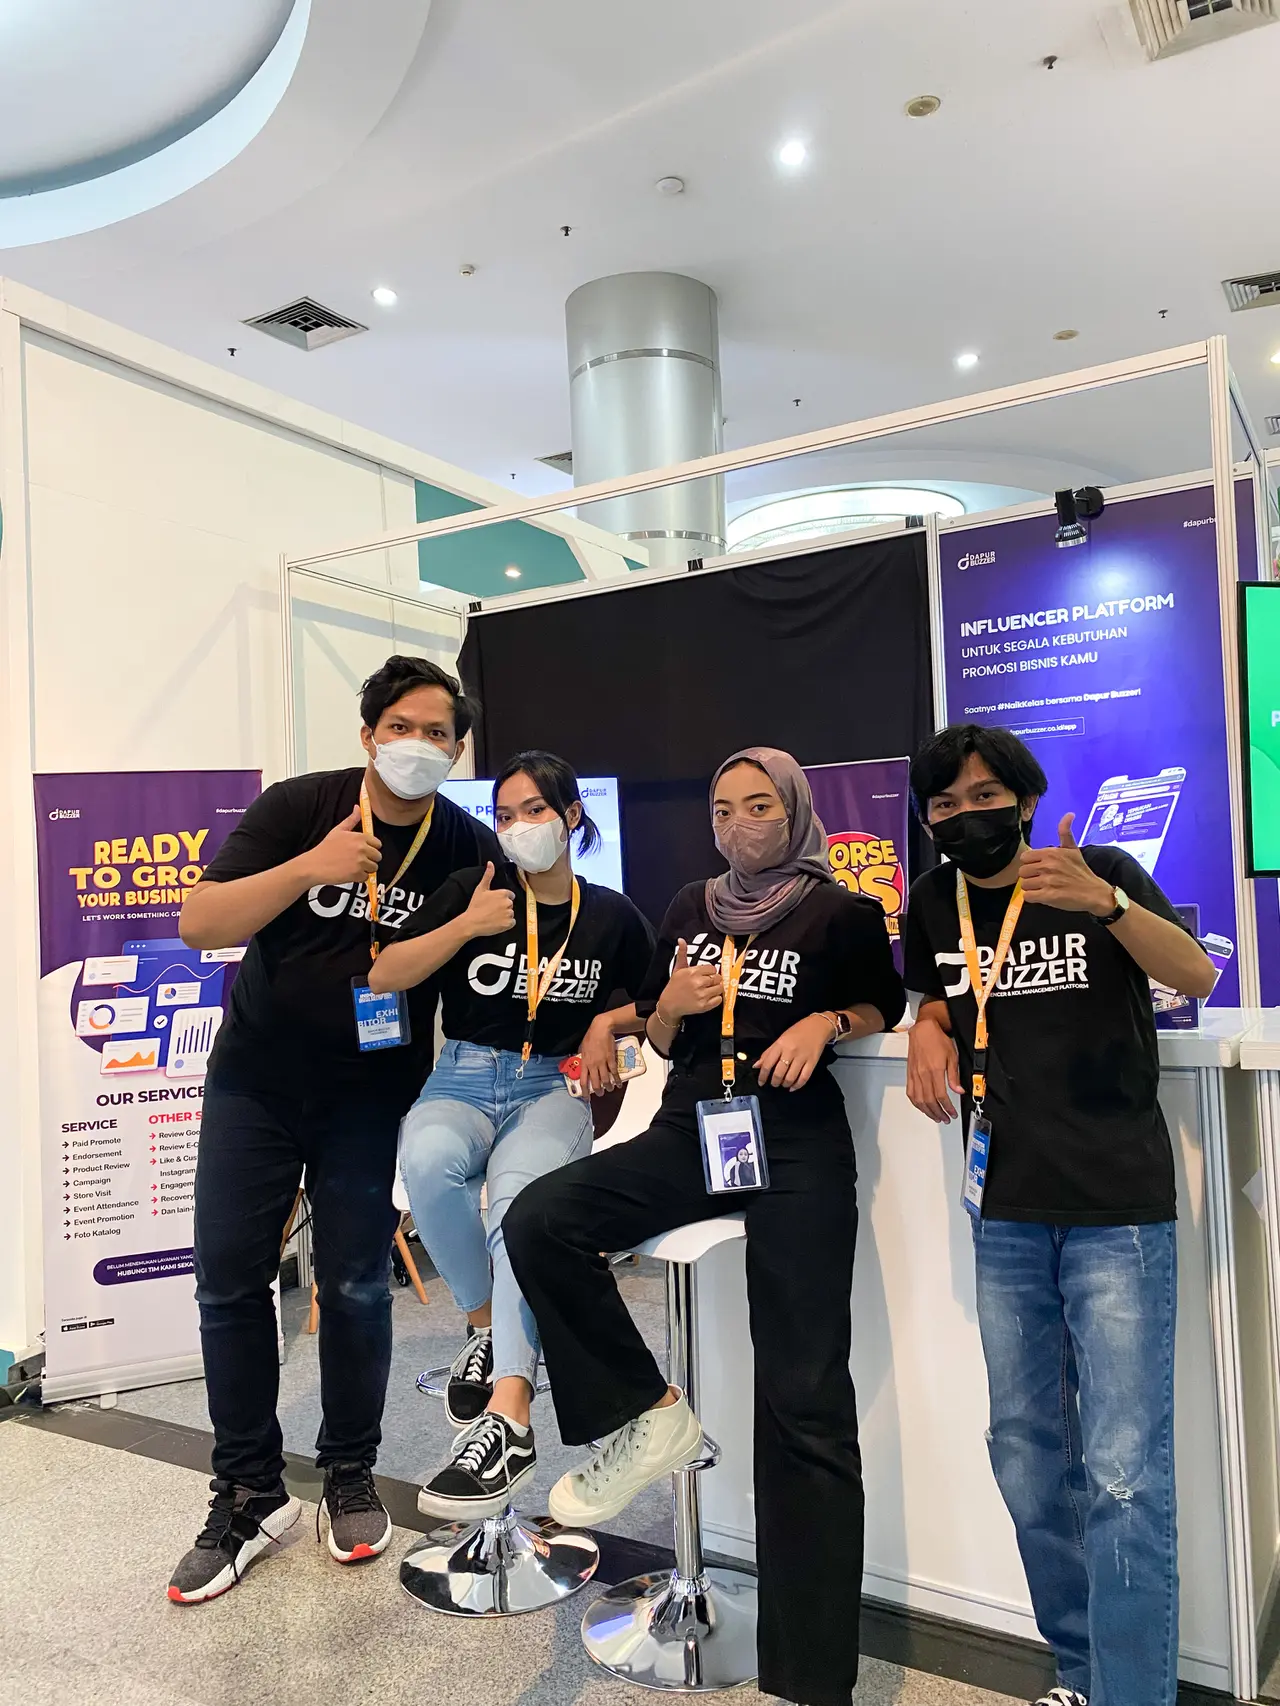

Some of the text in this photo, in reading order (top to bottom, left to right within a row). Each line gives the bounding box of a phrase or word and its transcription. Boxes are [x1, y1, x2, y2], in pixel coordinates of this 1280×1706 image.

[969, 551, 996, 561] DAPUR
[970, 557, 996, 567] BUZZER
[960, 592, 1175, 637] INFLUENCER PLATFORM
[961, 626, 1128, 659] UNTUK SEGALA KEBUTUHAN
[962, 651, 1098, 679] PROMOSI BISNIS KAMU
[964, 705, 997, 715] Saatnya
[997, 699, 1045, 711] #NaikKelas
[1045, 694, 1082, 706] bersama
[1083, 692, 1110, 703] Dapur
[94, 828, 209, 865] READY
[69, 865, 208, 890] TO GRO
[77, 891, 121, 908] YOUR
[82, 914, 101, 922] LET'S
[103, 912, 125, 920] WORK
[127, 911, 169, 919] SOMETHING
[976, 932, 1087, 967] DAPUR
[513, 974, 599, 999] BZZER
[1022, 985, 1059, 995] MANAGEMENT
[375, 1008, 398, 1018] EXHI
[96, 1092, 134, 1107] OUR
[148, 1112, 193, 1125] OTHER
[61, 1119, 118, 1133] SERVICE
[158, 1130, 184, 1139] Review
[72, 1137, 122, 1148] Paid Promote
[159, 1143, 185, 1151] Review
[72, 1150, 122, 1160] Endorsement
[159, 1156, 175, 1164] Like
[73, 1162, 131, 1173] Product Review
[160, 1167, 195, 1177] Instagram
[73, 1178, 111, 1187] Campaign
[161, 1193, 194, 1202] Recovery
[73, 1200, 139, 1212] Event Attendance
[161, 1207, 176, 1215] Dan
[74, 1213, 135, 1225] Event Promotion
[92, 1228, 121, 1237] Katalog
[117, 1267, 147, 1277] HUBUNGI
[160, 1263, 177, 1271] KAMI
[177, 1261, 194, 1269] SEKA
